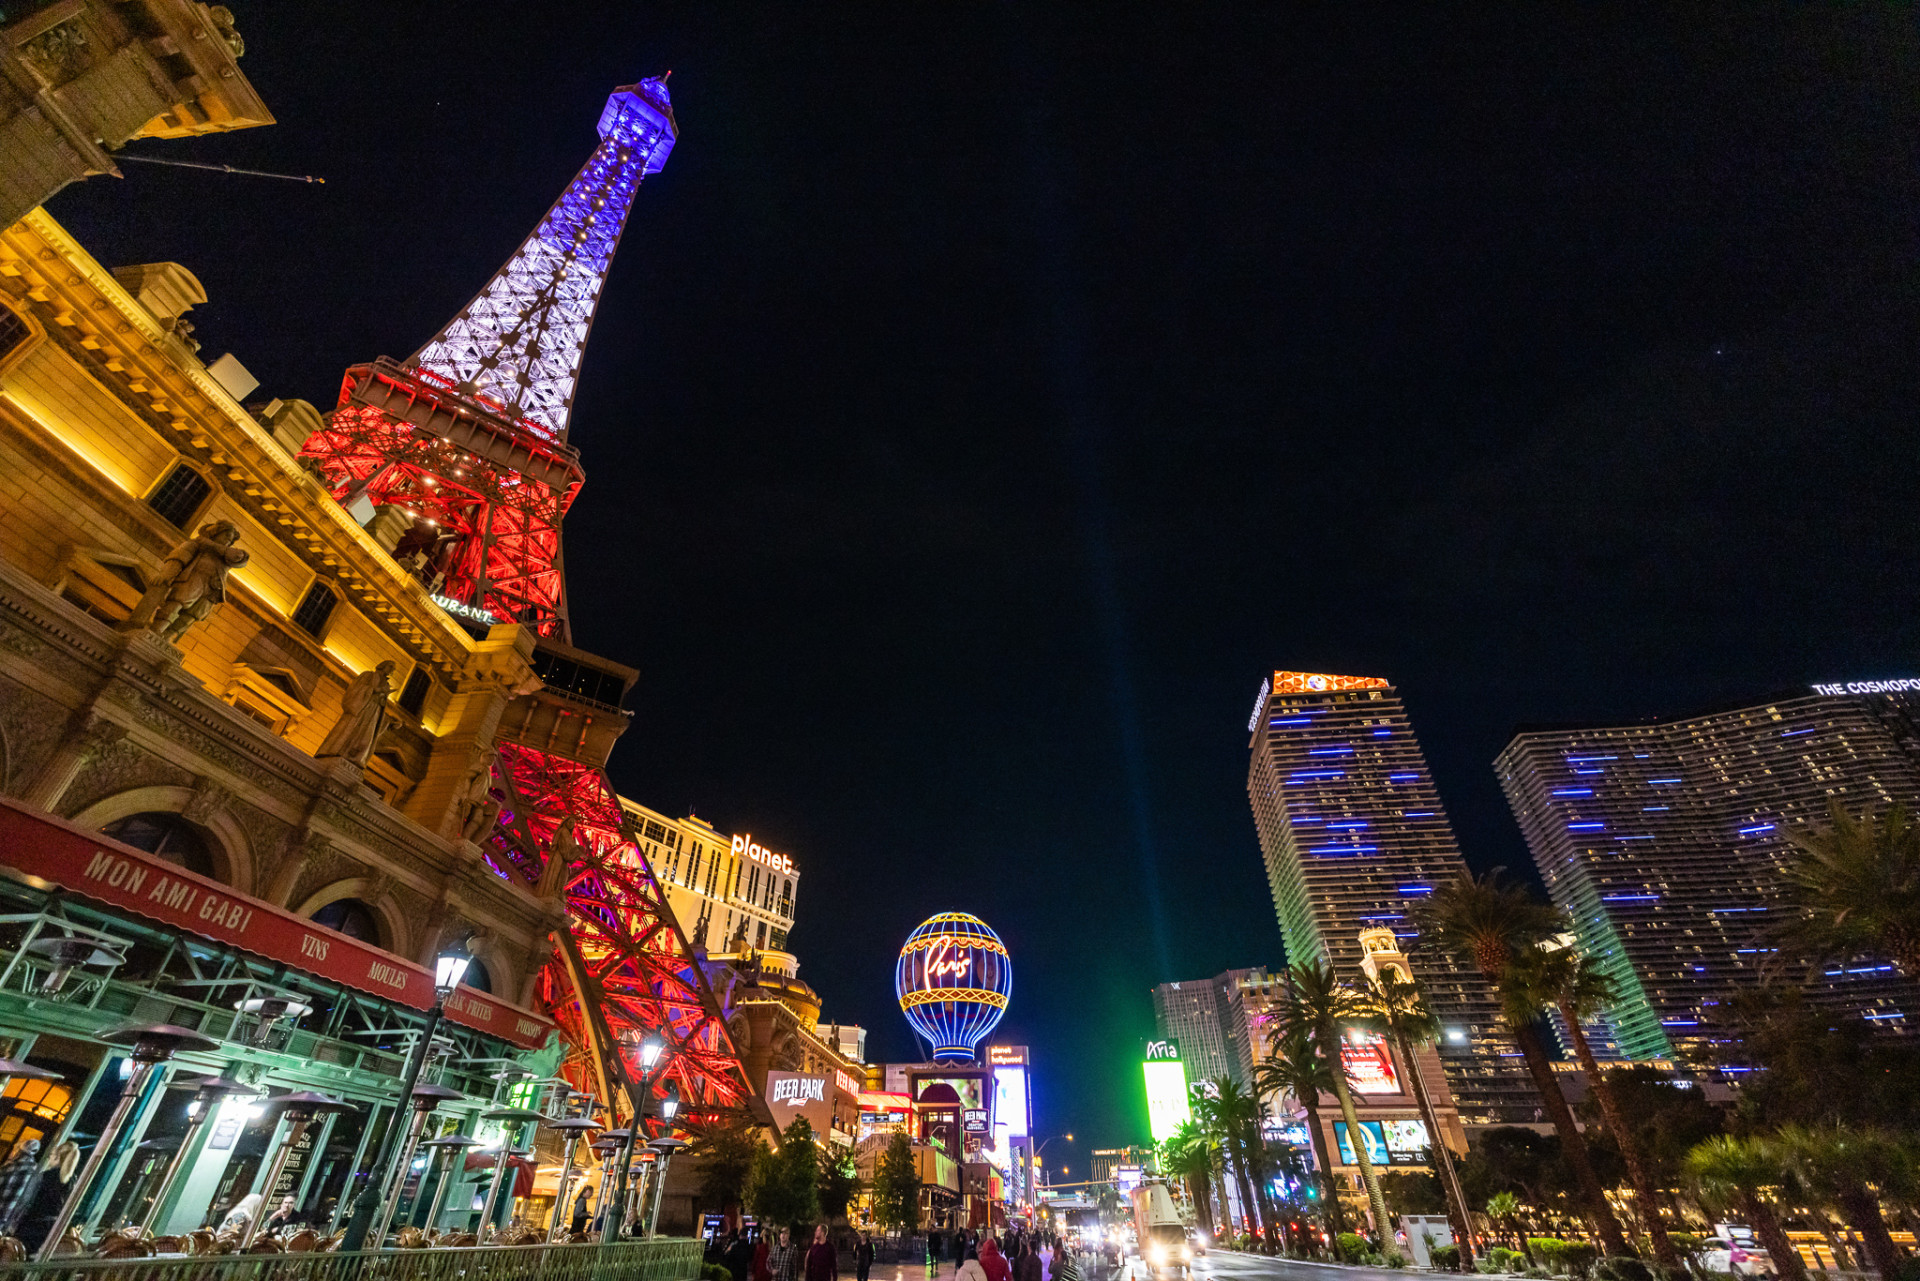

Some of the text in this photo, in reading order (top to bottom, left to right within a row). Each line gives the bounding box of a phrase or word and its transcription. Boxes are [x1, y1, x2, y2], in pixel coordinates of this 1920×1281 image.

[1812, 678, 1920, 696] THE COSMOPO
[730, 832, 793, 875] planet
[84, 852, 253, 933] MON AMI GABI
[301, 934, 330, 961] VINS
[368, 961, 408, 990] MOULES
[924, 935, 971, 993] Paris
[466, 999, 493, 1022] FRITES
[1146, 1041, 1177, 1060] Aria
[773, 1078, 825, 1102] BEER PARK
